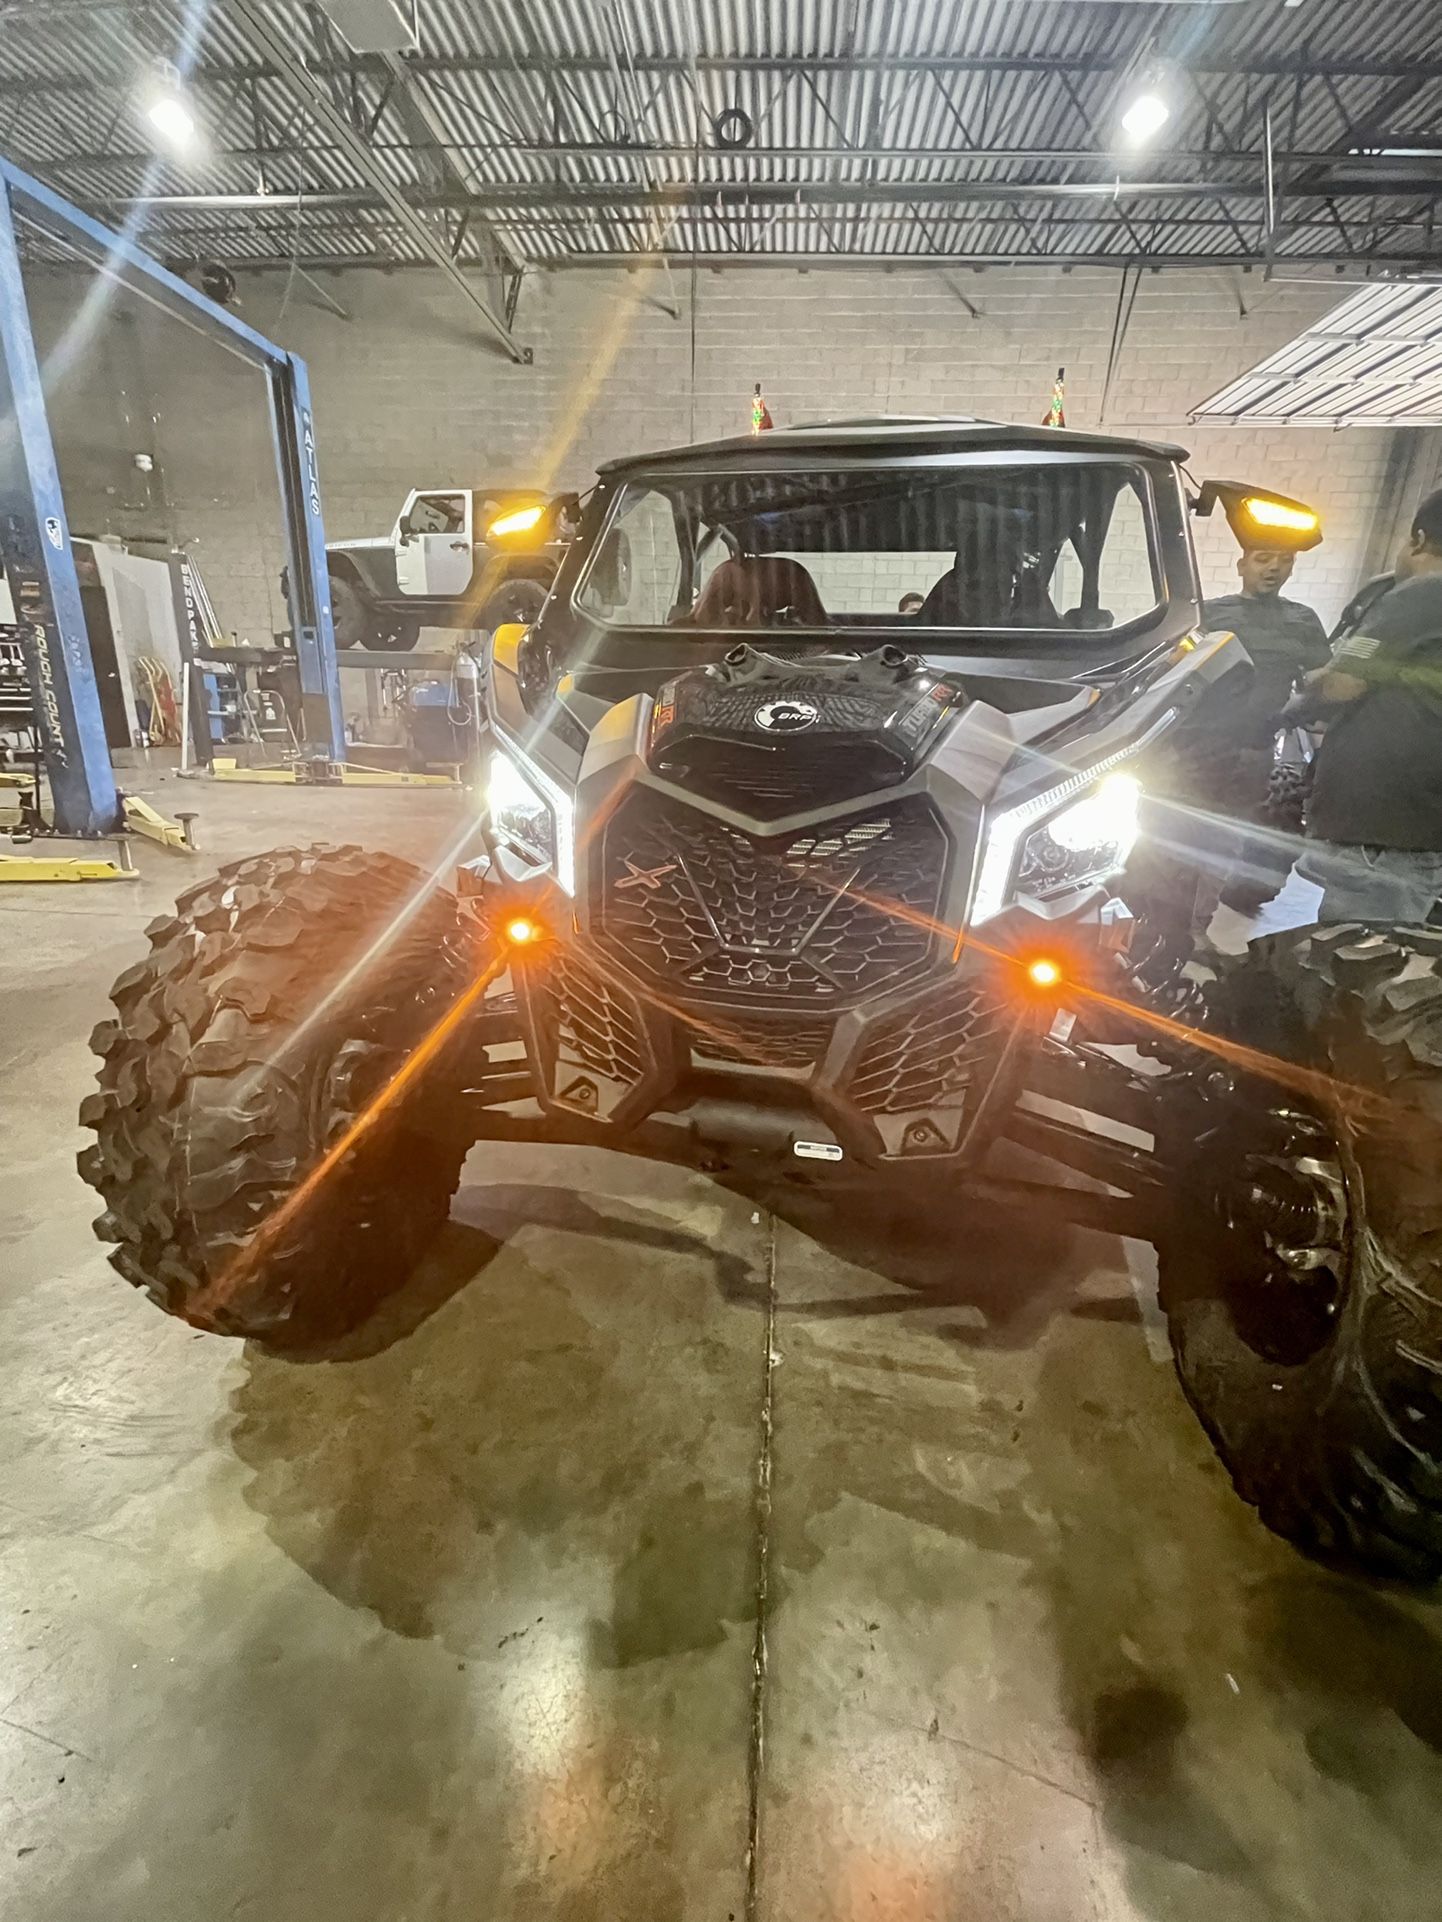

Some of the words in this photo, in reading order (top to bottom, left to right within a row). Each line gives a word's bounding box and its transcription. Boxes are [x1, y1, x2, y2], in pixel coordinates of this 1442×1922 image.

[305, 430, 319, 515] ATLAS
[34, 624, 53, 684] ROUGH
[931, 683, 953, 702] RR
[778, 712, 812, 721] BRP
